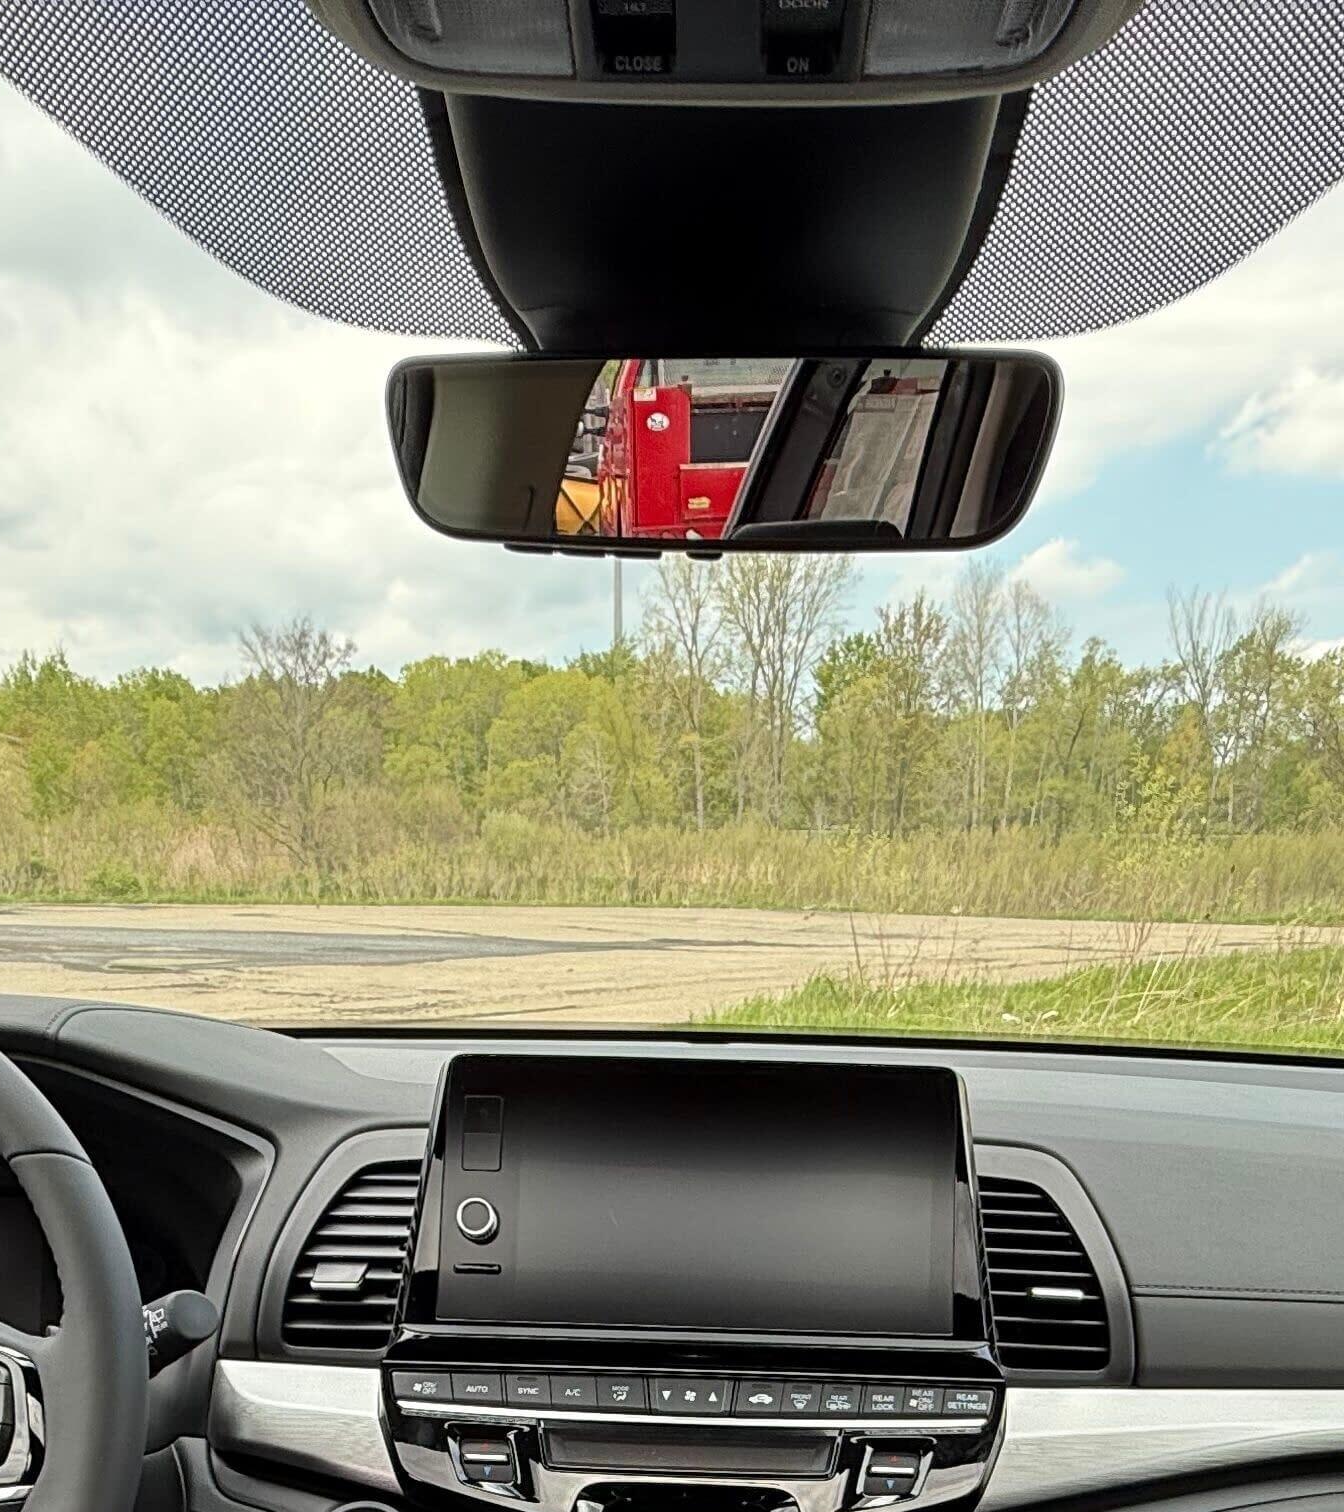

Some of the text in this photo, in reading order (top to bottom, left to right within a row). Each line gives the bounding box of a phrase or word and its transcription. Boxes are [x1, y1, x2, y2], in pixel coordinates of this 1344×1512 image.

[614, 55, 664, 72] CLOSE
[786, 57, 810, 73] ON
[465, 1385, 489, 1394] AUTO
[517, 1386, 539, 1395] SYNC
[565, 1388, 581, 1397] A/C
[912, 1389, 934, 1397] REAR
[872, 1394, 895, 1402] REAR
[956, 1393, 979, 1402] REAR
[872, 1402, 895, 1411] LOCK
[947, 1401, 987, 1411] SETTINGS
